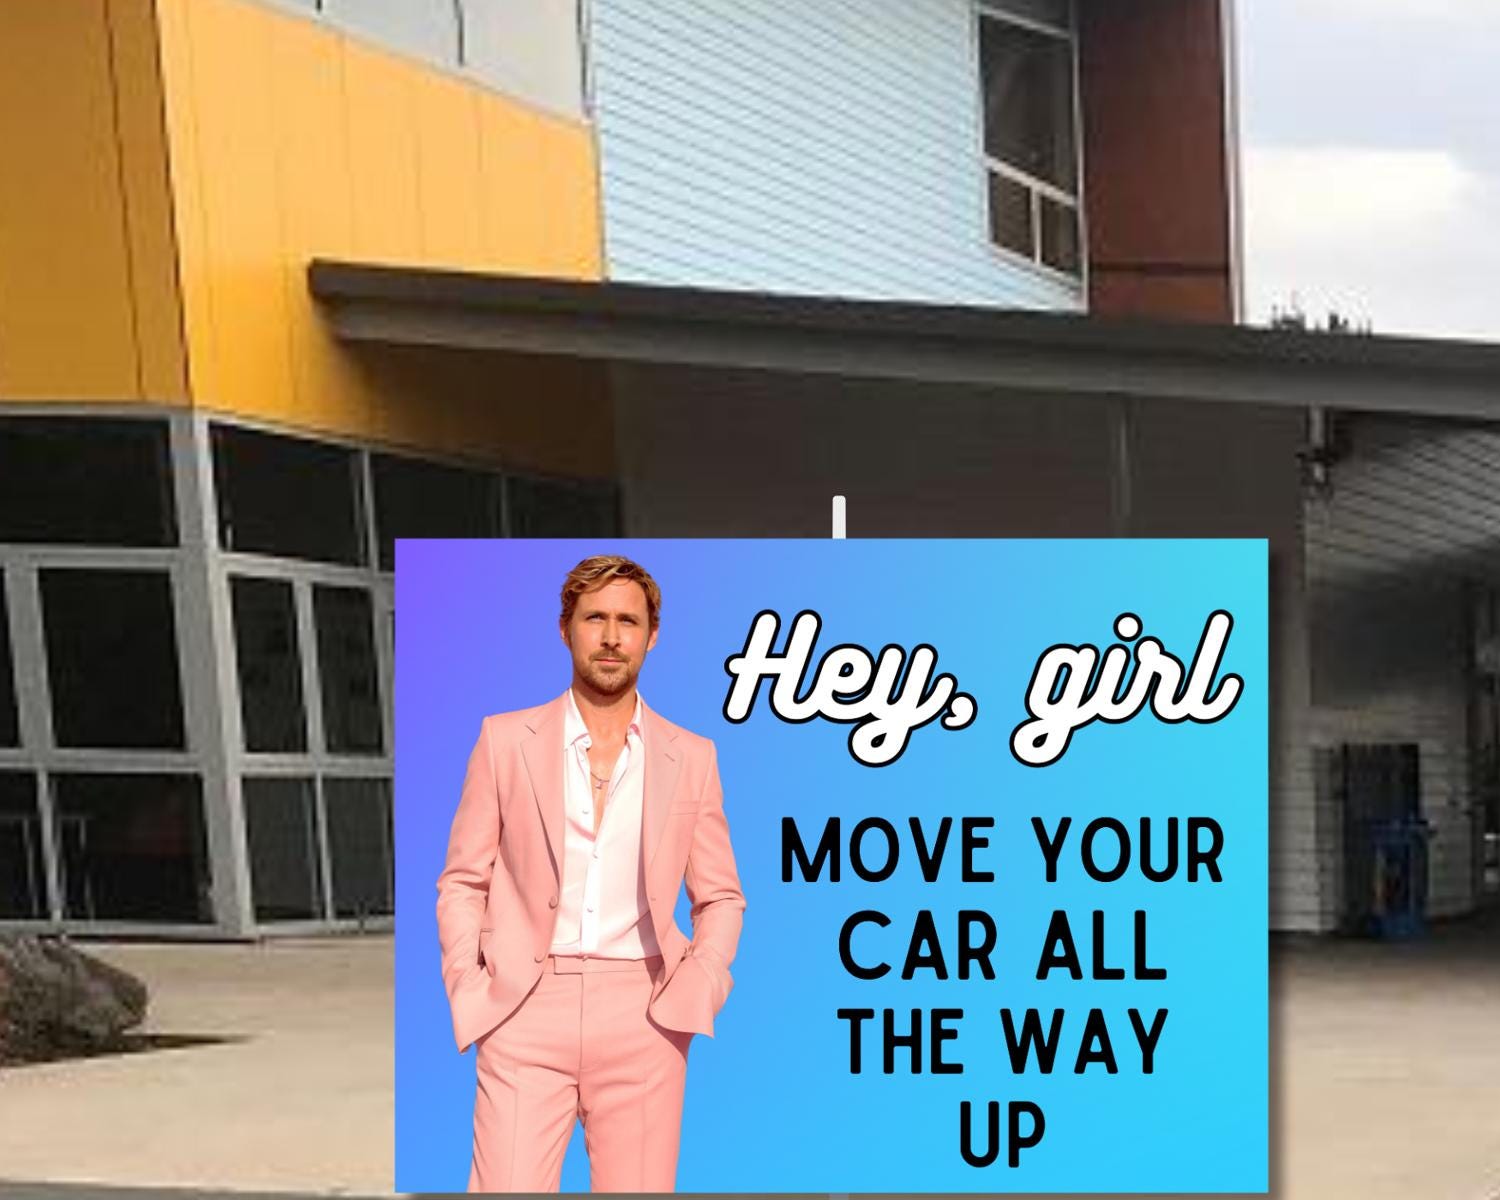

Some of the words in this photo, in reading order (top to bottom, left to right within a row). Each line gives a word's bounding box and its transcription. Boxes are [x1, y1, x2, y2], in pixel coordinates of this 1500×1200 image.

[722, 609, 978, 768] Hey,
[1009, 609, 1244, 768] girl
[781, 816, 995, 883] MOVE
[1031, 816, 1224, 883] YOUR
[838, 909, 998, 981] CAR
[1036, 909, 1168, 981] ALL
[837, 1008, 964, 1075] THE
[1000, 1008, 1169, 1075] WAY
[959, 1100, 1046, 1169] UP
